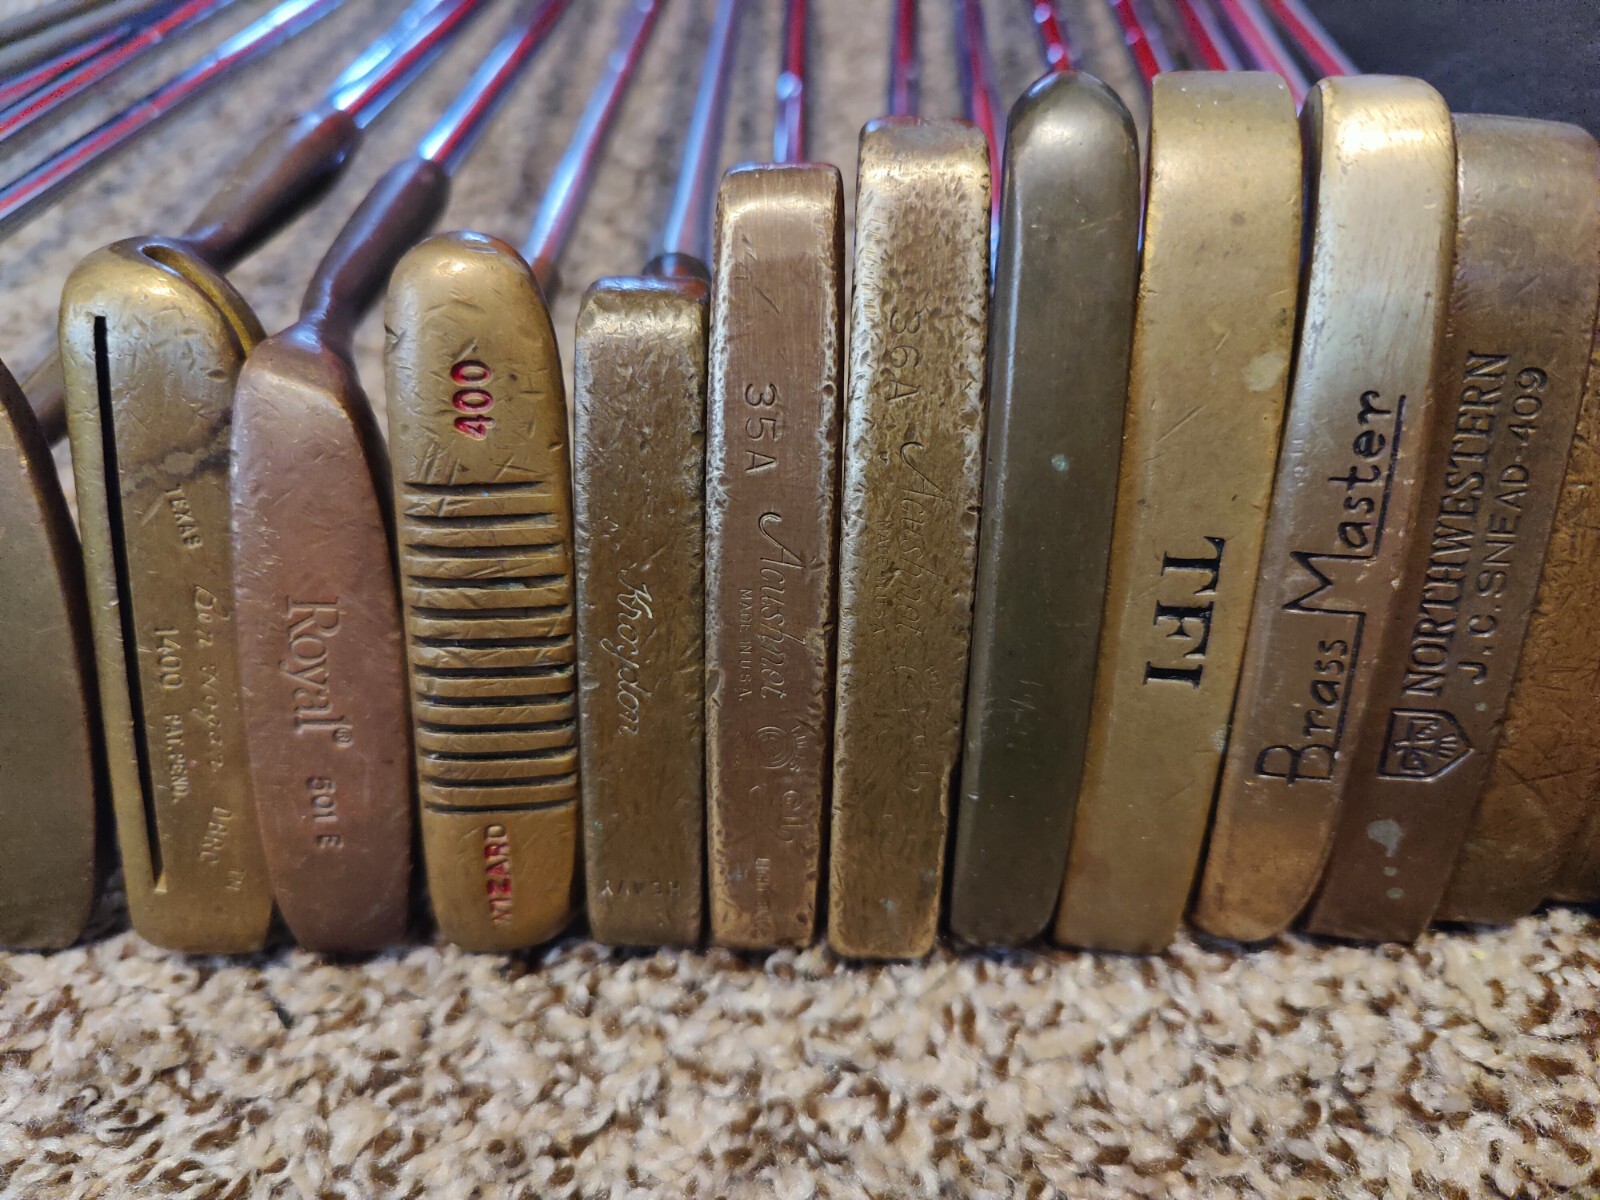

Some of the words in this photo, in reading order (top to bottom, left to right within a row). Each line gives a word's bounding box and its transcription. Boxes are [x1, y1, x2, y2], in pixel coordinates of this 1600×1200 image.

[449, 359, 496, 441] 400
[887, 308, 924, 402] 36A
[745, 383, 778, 473] 35A
[165, 483, 203, 549] TEXAS
[896, 441, 947, 637] Acushnet
[1281, 389, 1393, 618] Master
[1401, 349, 1511, 699] NORTHWESTERN
[154, 626, 184, 689] 1400
[600, 570, 653, 737] Kroydon
[738, 588, 753, 634] MADE
[758, 511, 806, 700] Acushnet
[1143, 535, 1226, 690] TFI
[1254, 637, 1349, 786] Brass
[306, 775, 338, 822] 501
[483, 823, 513, 928] WIZARD
